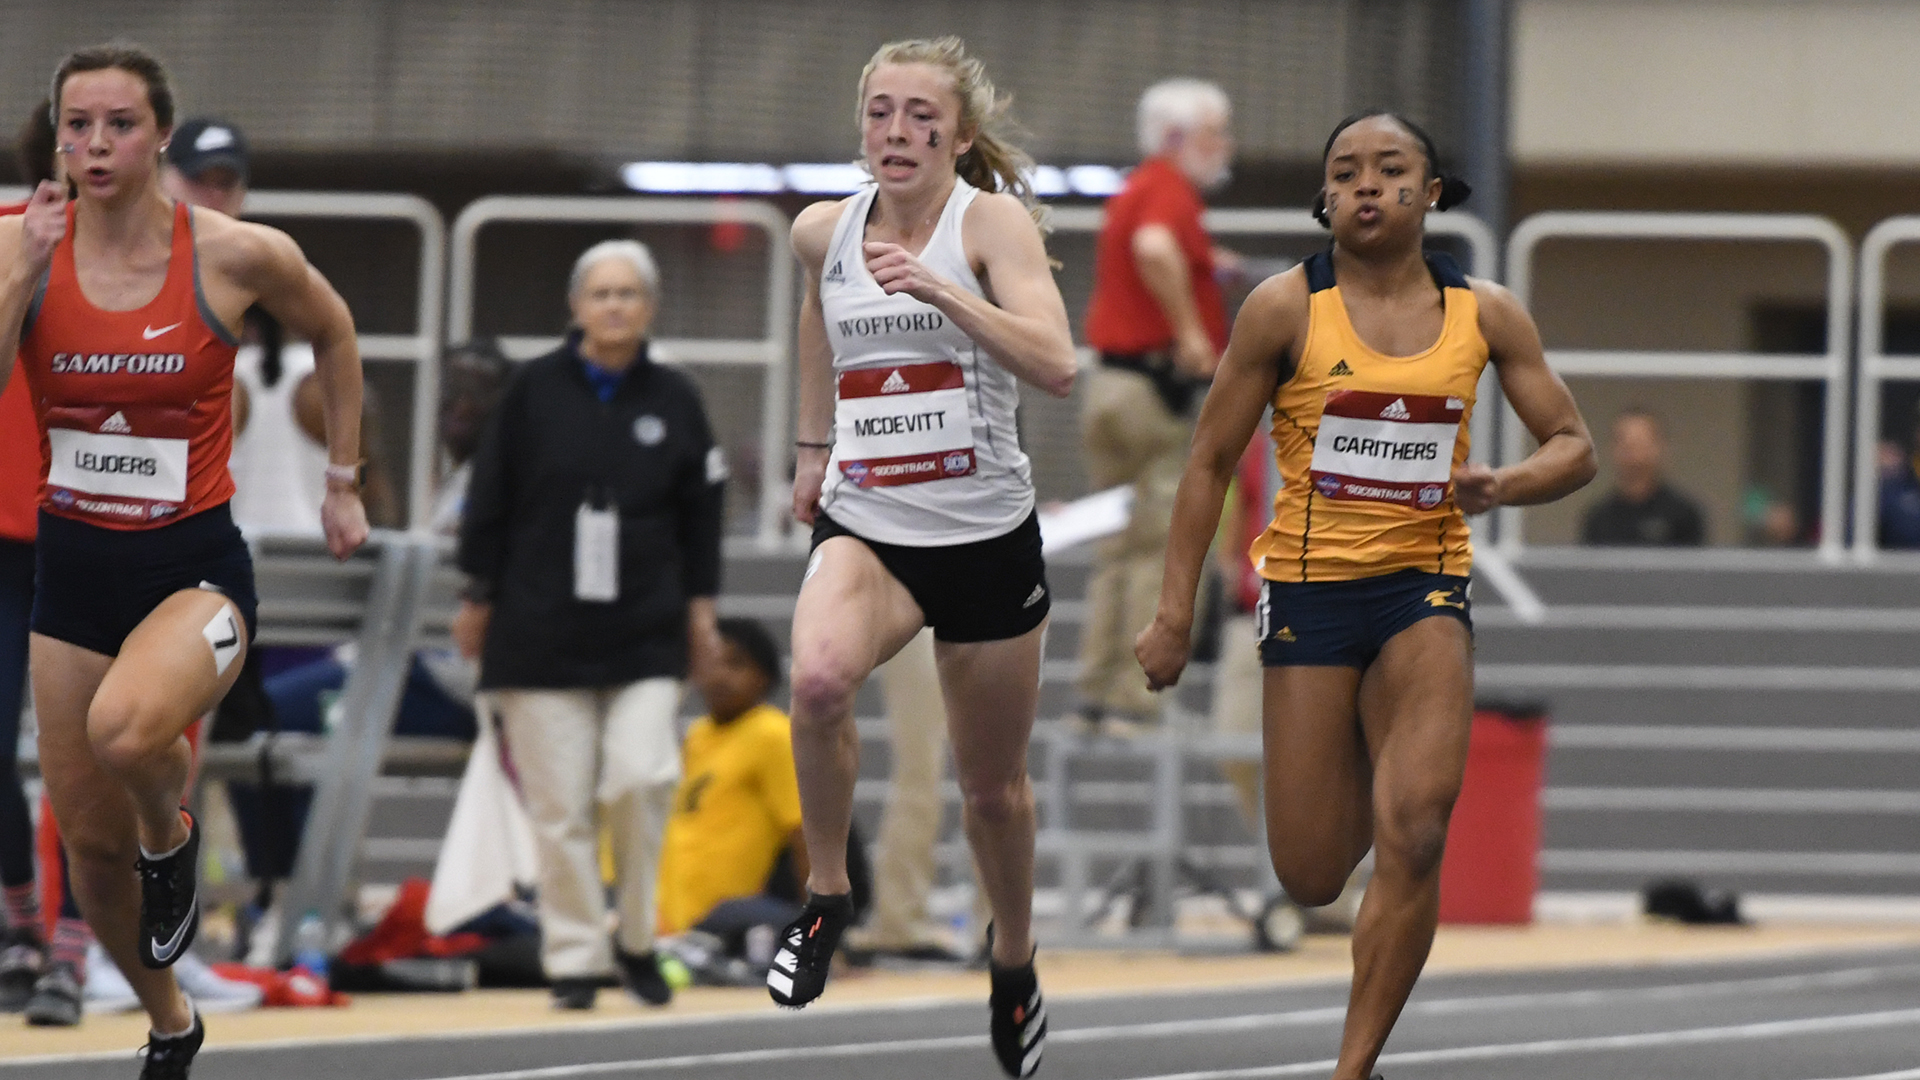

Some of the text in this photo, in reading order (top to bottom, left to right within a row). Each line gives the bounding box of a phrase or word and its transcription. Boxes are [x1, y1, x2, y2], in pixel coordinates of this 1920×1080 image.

[838, 312, 943, 337] WOFFORD
[51, 352, 185, 374] SAMFORD
[854, 410, 946, 437] MCDEVITT
[1333, 435, 1438, 460] CARITHERS
[75, 450, 157, 476] LEUDERS
[214, 616, 237, 649] 7
